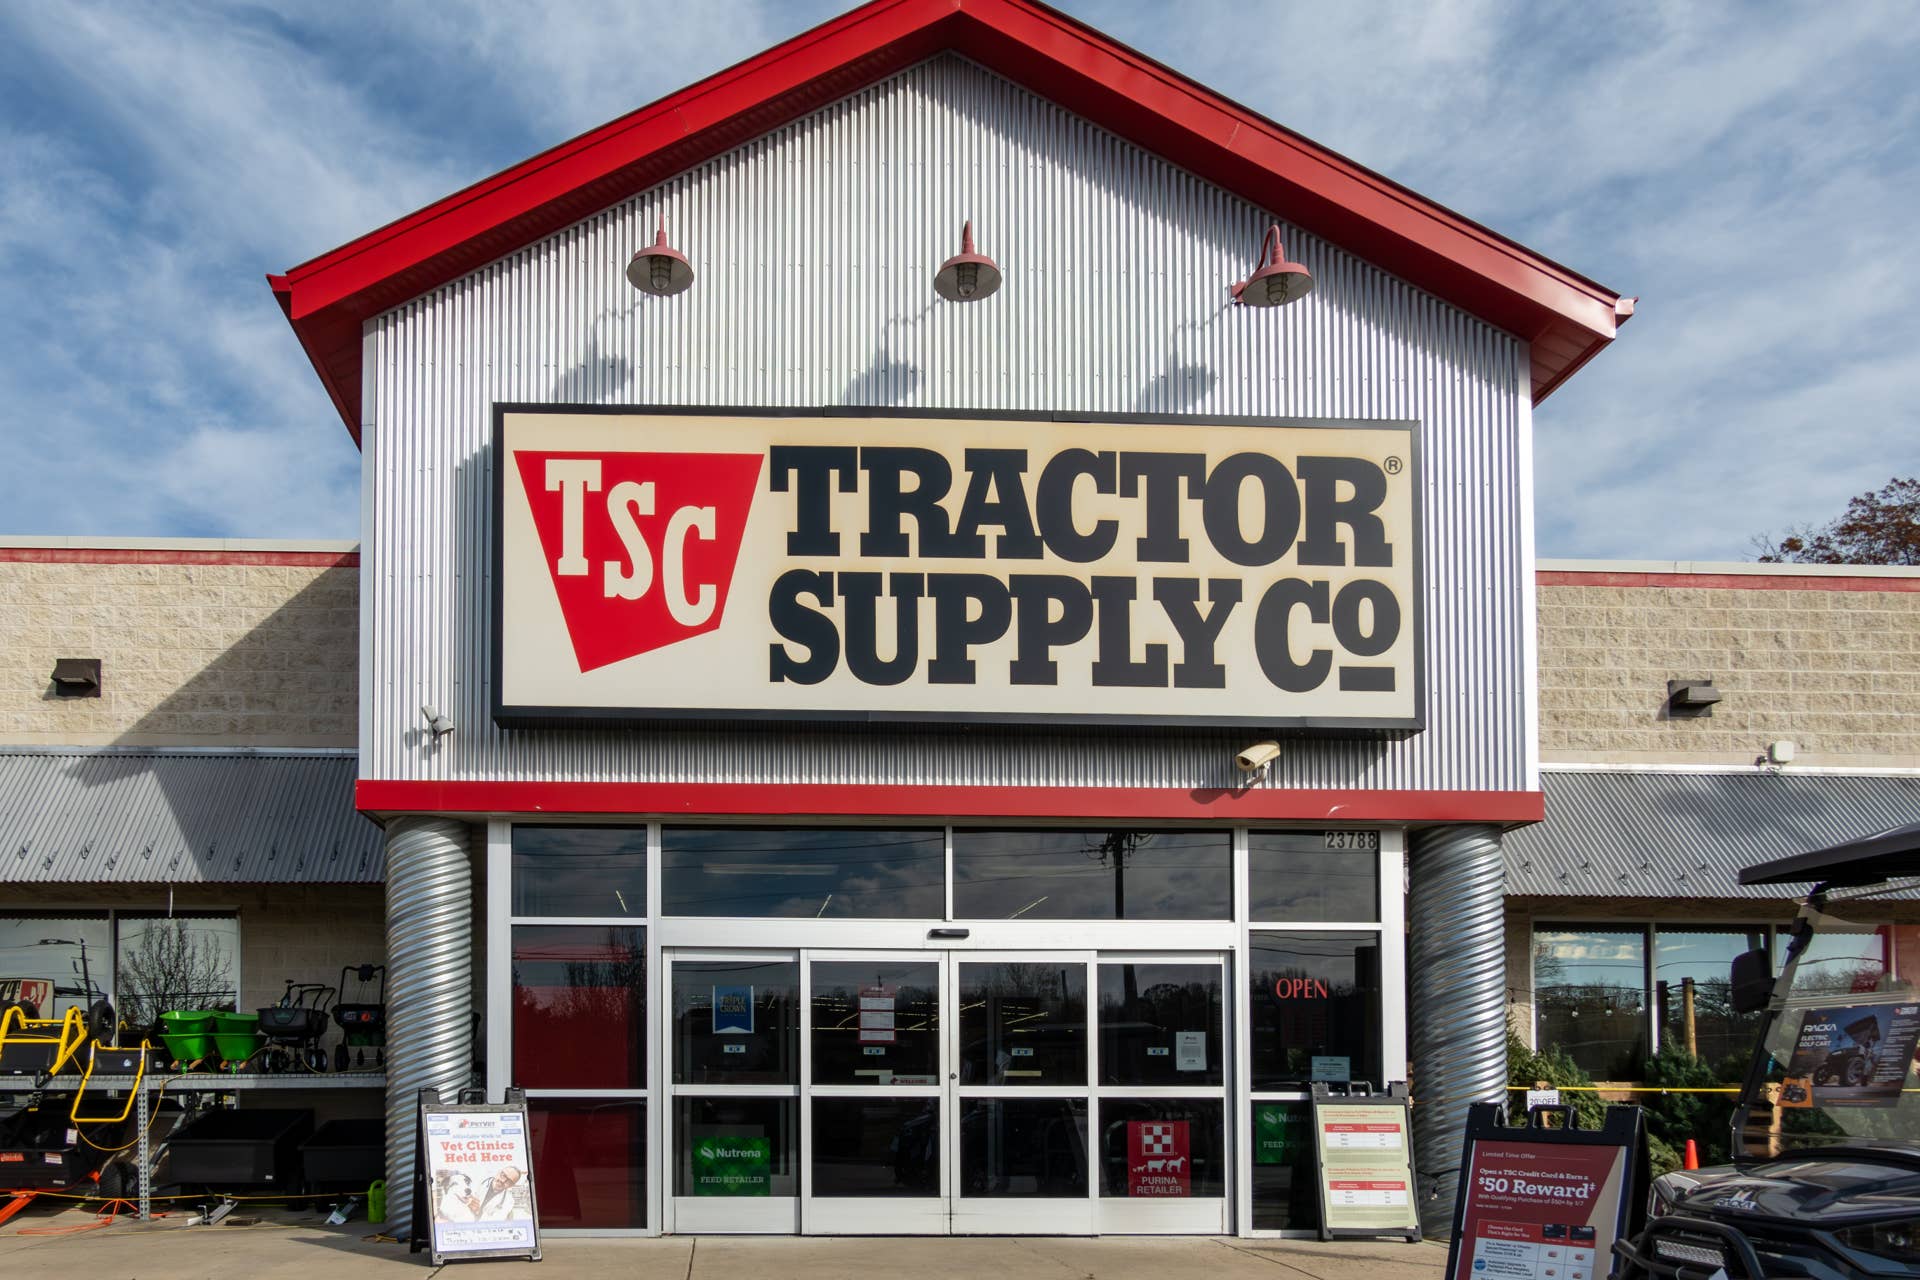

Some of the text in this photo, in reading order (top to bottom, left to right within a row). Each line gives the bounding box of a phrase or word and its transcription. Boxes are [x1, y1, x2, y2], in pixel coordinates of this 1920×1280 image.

[769, 445, 1393, 567] TRACTOR
[545, 459, 717, 626] TSC
[769, 569, 1243, 689] SUPPLY
[1325, 831, 1377, 849] 23788
[1276, 978, 1328, 999] OPEN
[440, 1140, 515, 1151] Vet Clinics
[1263, 1140, 1285, 1149] FEED
[444, 1152, 513, 1163] Held Here
[716, 1148, 761, 1158] Nutrena
[1520, 1152, 1536, 1160] Offer
[1479, 1167, 1497, 1176] Open
[1518, 1170, 1540, 1178] Credit
[1540, 1171, 1558, 1179] Card
[700, 1176, 764, 1184] FEED RETAILER
[1141, 1176, 1178, 1185] PURINA
[1478, 1176, 1508, 1193] $50
[1136, 1185, 1183, 1194] RETAILER
